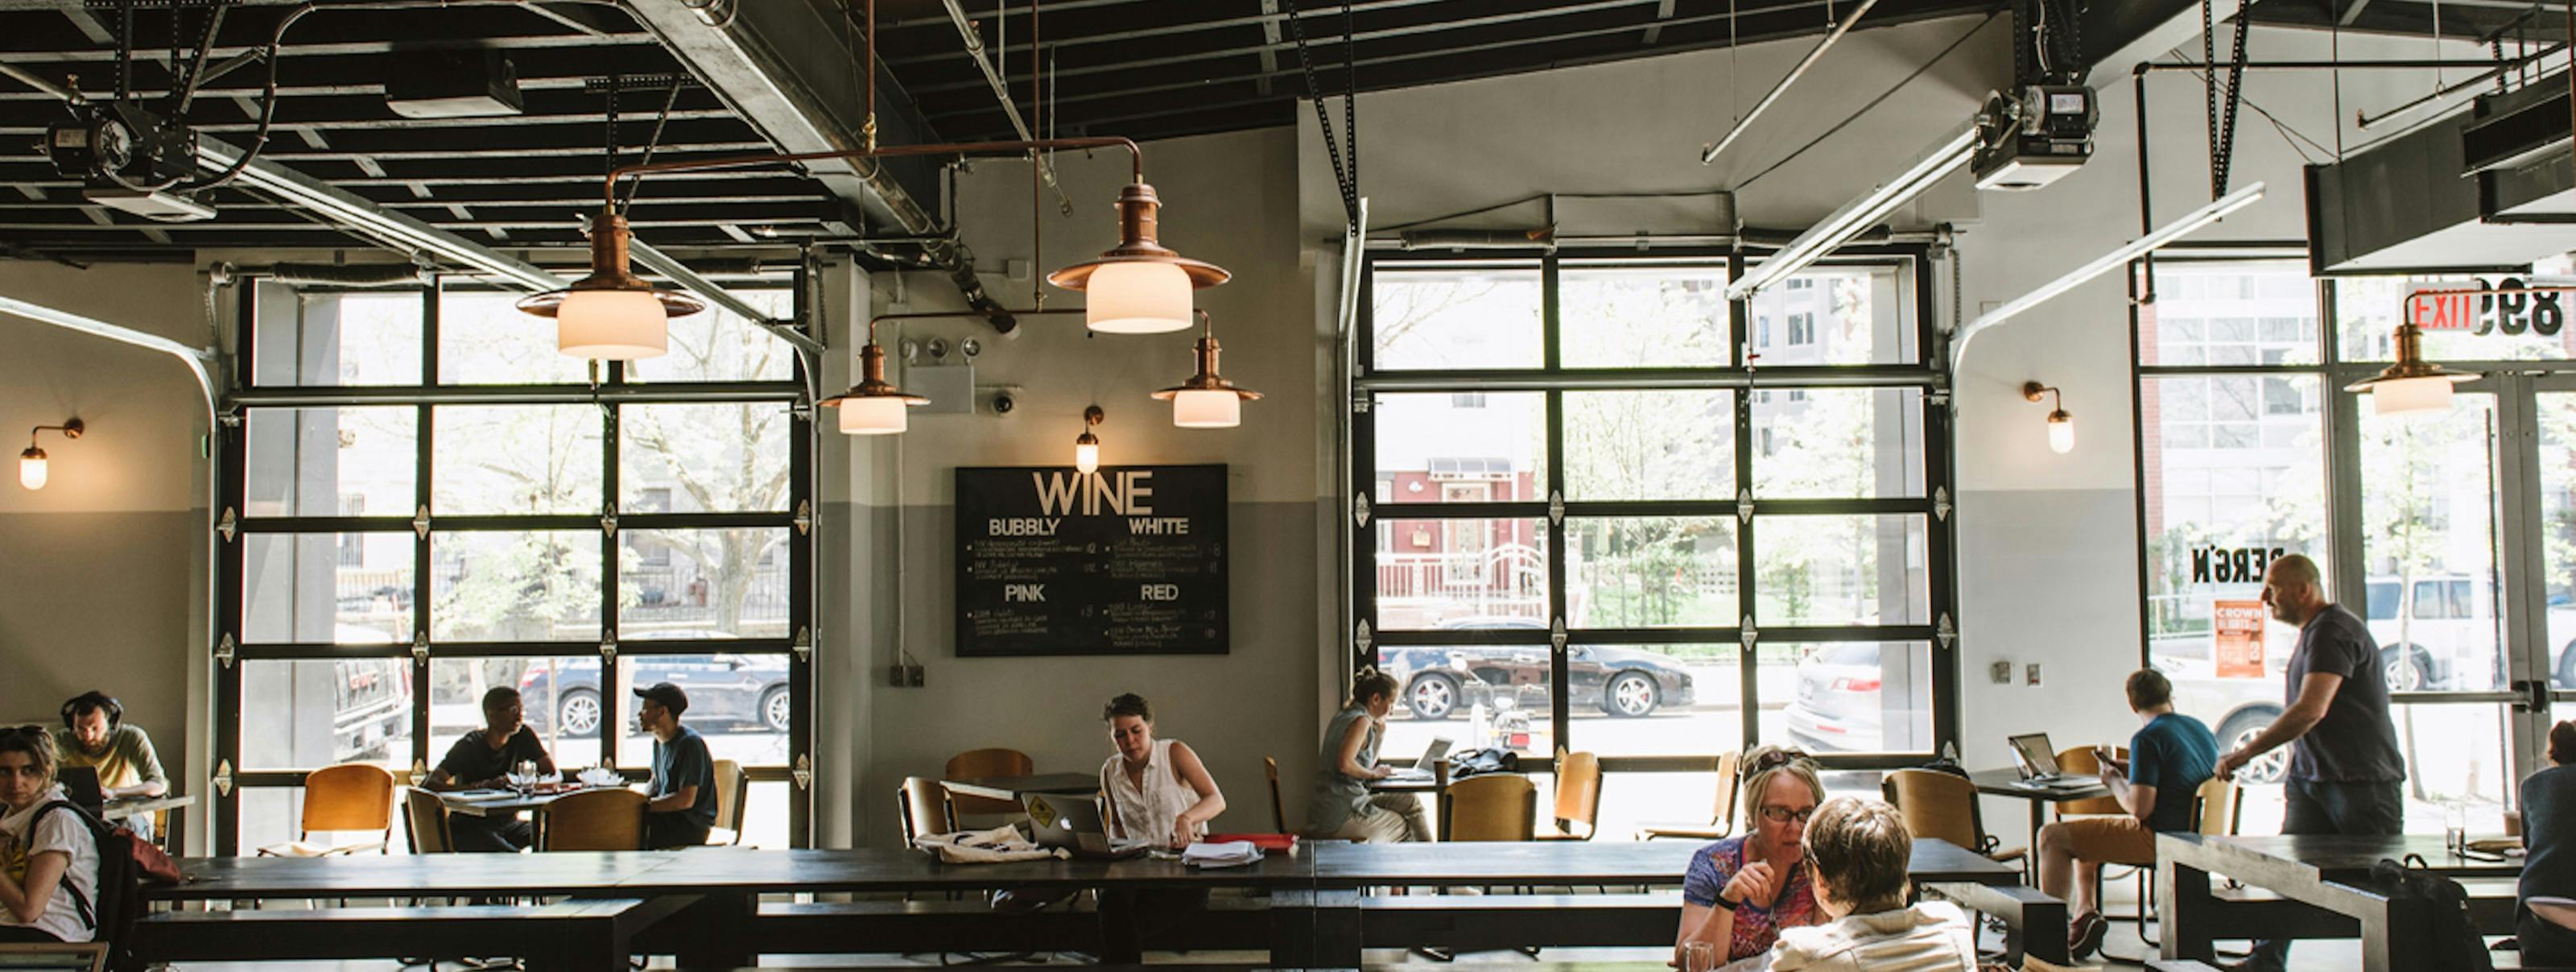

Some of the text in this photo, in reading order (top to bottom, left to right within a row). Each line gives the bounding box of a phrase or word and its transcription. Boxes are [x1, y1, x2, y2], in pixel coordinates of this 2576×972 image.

[2415, 288, 2475, 329] EXIT
[1032, 470, 1153, 515] WINE
[989, 518, 1061, 536] BUBBLY
[1129, 518, 1189, 534] WHITE
[1005, 585, 1046, 602] PINK
[1141, 584, 1179, 601] RED
[2216, 607, 2263, 619] CROWN
